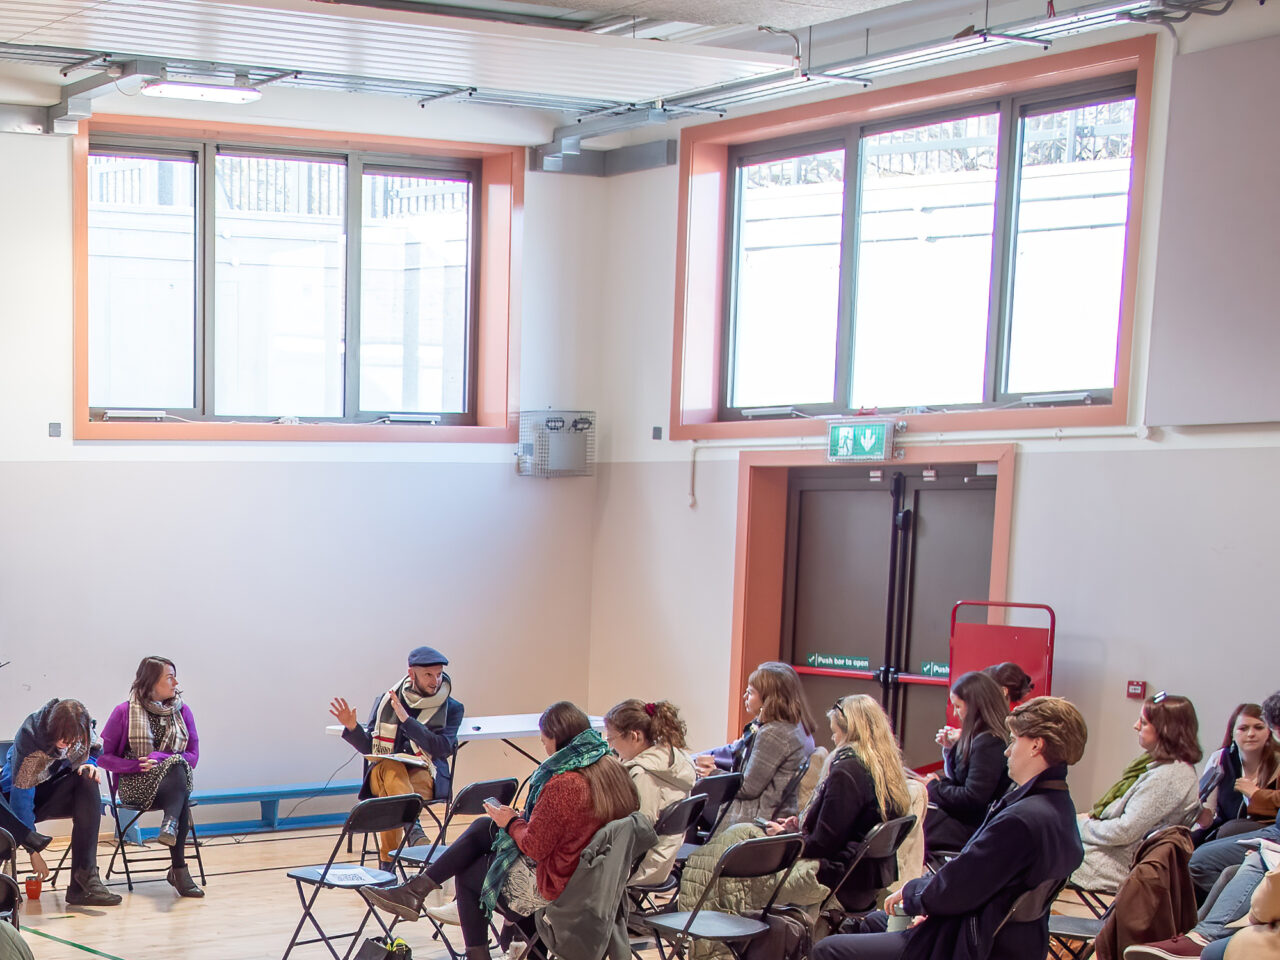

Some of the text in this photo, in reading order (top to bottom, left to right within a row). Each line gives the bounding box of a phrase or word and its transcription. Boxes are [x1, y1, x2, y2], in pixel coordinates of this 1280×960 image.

[818, 655, 869, 668] Push bar to open
[933, 664, 950, 674] Push
